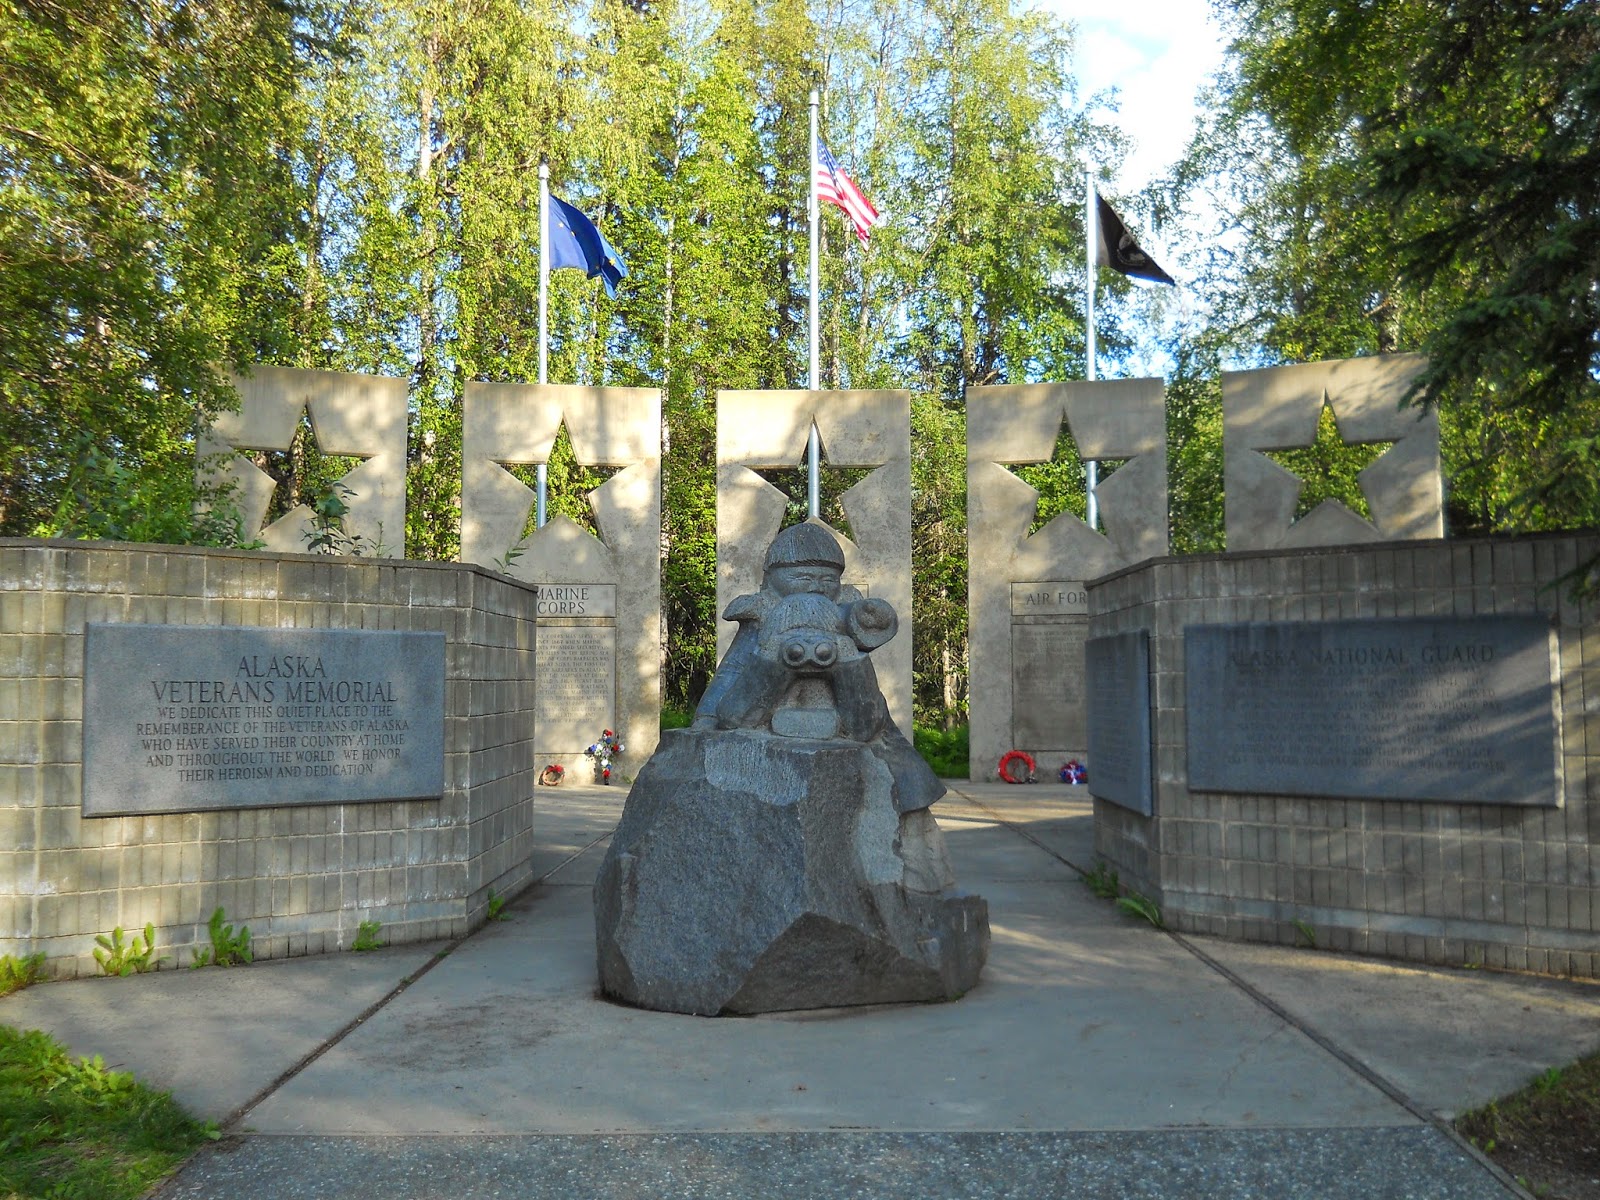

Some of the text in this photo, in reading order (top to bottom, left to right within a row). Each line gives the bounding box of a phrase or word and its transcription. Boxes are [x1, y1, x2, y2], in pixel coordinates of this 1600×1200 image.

[536, 587, 590, 600] MARINE
[1026, 591, 1050, 605] AIR
[537, 601, 585, 614] CORPS
[1225, 645, 1495, 666] ALASKA NATIONAL GUARD
[236, 655, 327, 678] ALASKA
[151, 680, 399, 703] VETERANS MEMORIAL
[158, 705, 393, 719] WE DEDICATE THIS QUIET PLACE TO THE
[136, 719, 410, 735] REMEMBERANCE OF THE VETERANS OF ALASKA
[141, 733, 406, 751] WHO HAVE SERVED THEIR COUNTRY AT HOME
[146, 754, 174, 767] AND
[177, 752, 265, 766] THROUGHOUT
[269, 751, 292, 763] THE
[343, 749, 359, 761] WE
[362, 748, 401, 760] HONOR
[177, 763, 374, 782] THEIR HEROISM AND DEDICATION
